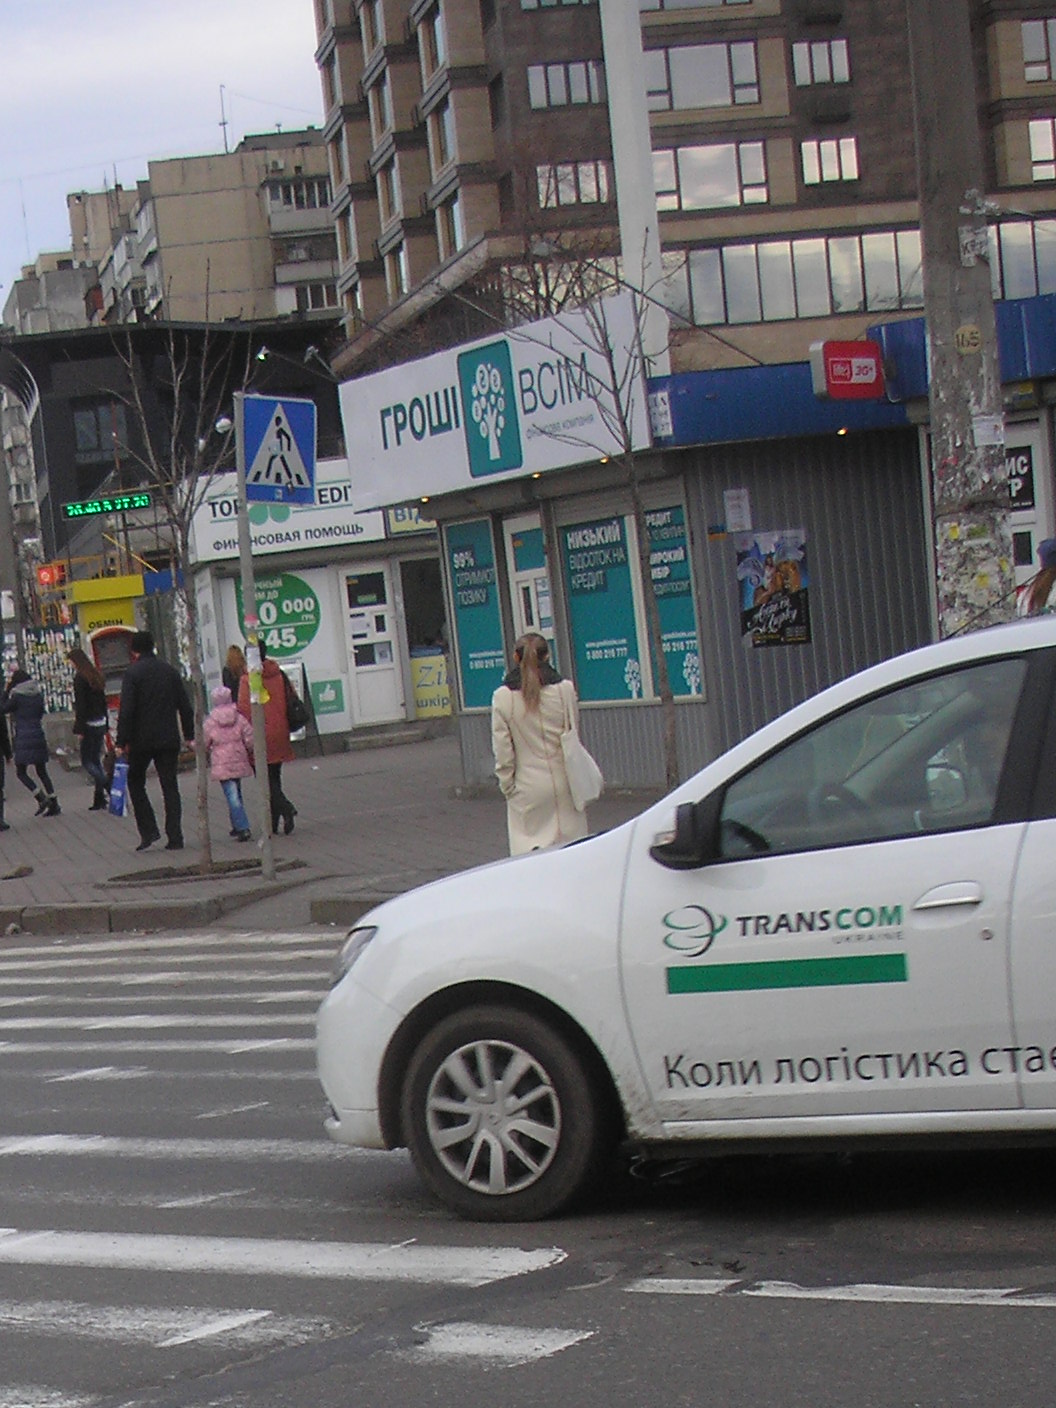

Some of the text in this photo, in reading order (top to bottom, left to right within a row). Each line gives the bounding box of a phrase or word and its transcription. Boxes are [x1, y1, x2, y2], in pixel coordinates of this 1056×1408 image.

[518, 351, 594, 415] ВСІМ
[380, 386, 461, 450] ГРОШІ
[212, 523, 364, 552] ФИННСОВАЯ ПОМОЩЬ
[567, 520, 621, 549] НИЗЬКИЙ
[265, 628, 298, 649] 45
[736, 904, 904, 937] TRANSCOM
[663, 1053, 763, 1089] Коли
[774, 1047, 968, 1084] логістика
